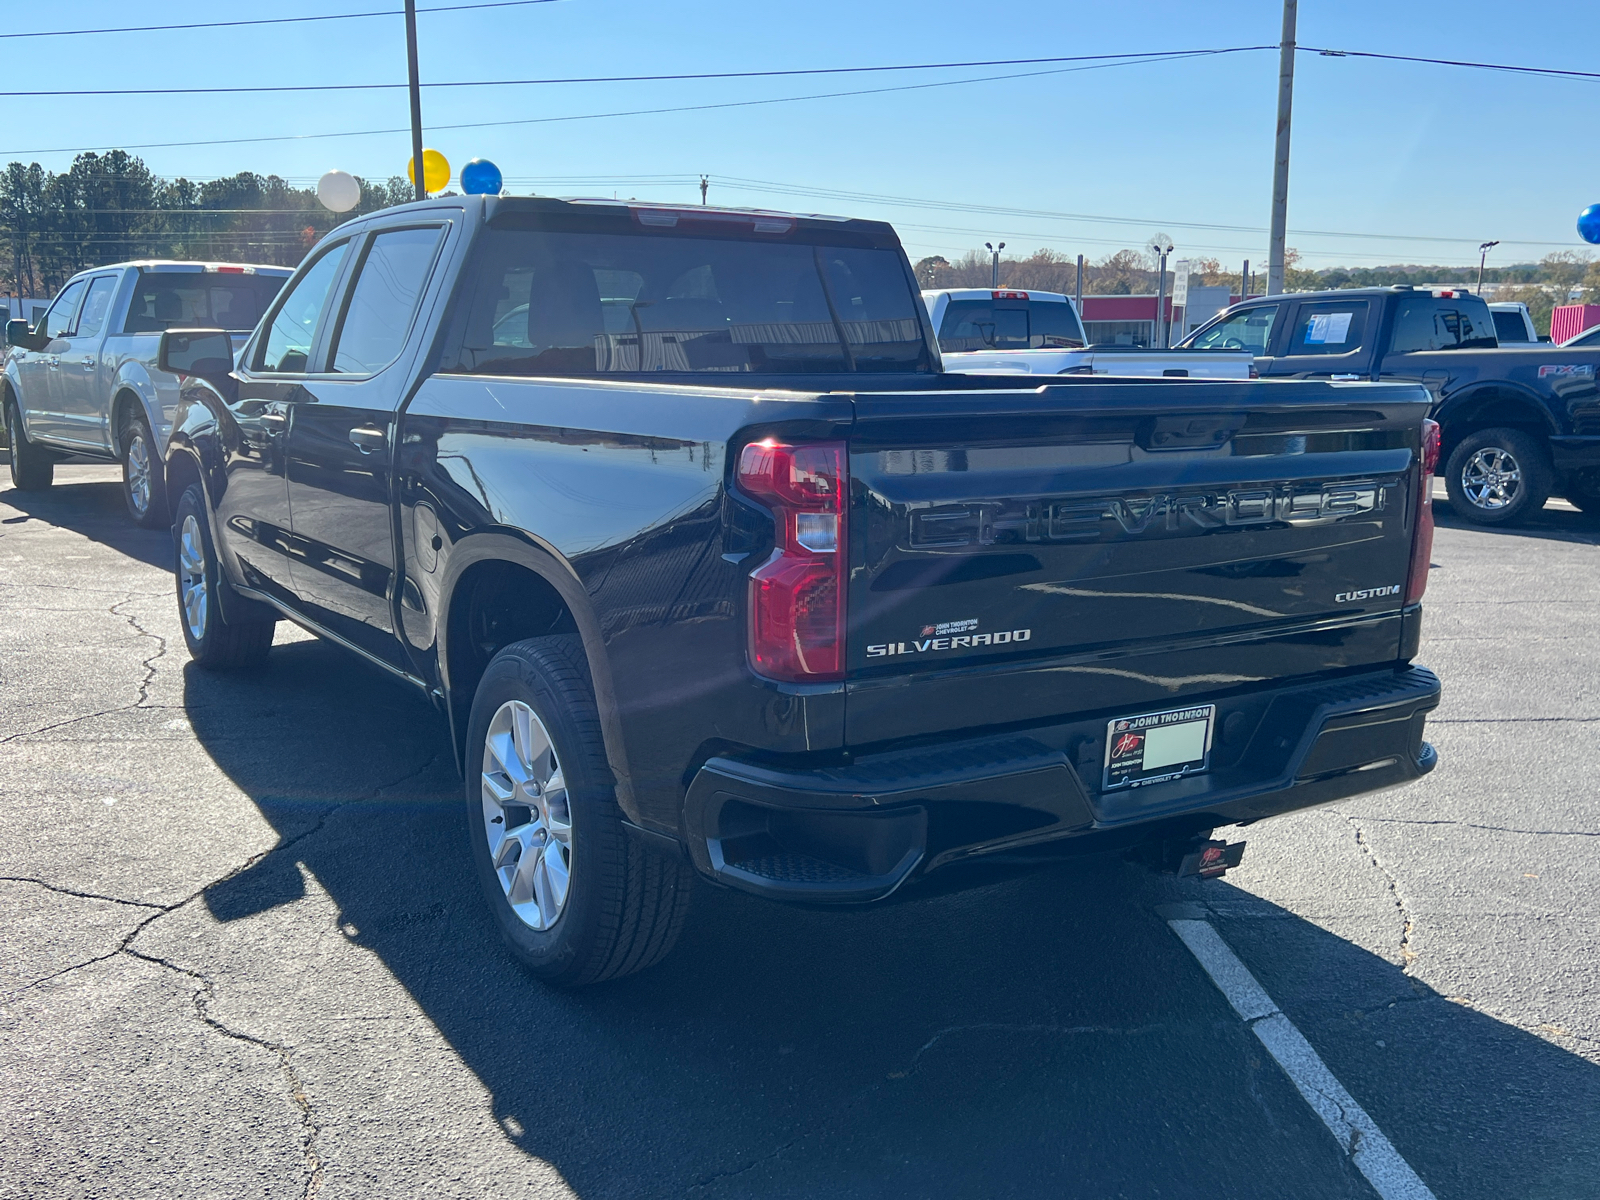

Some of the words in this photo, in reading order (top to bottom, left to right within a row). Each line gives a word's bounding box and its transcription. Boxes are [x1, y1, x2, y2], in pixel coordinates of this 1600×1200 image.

[1537, 364, 1593, 379] FX4
[908, 477, 1398, 548] CHEVROLET
[1335, 584, 1401, 603] CUSTOM
[935, 626, 967, 636] CHEVROLET
[936, 622, 950, 630] JOHN
[950, 618, 978, 628] THORNTON
[867, 629, 1031, 657] SILVERADO
[1134, 716, 1159, 727] JOHN
[1161, 708, 1210, 723] THORNTON
